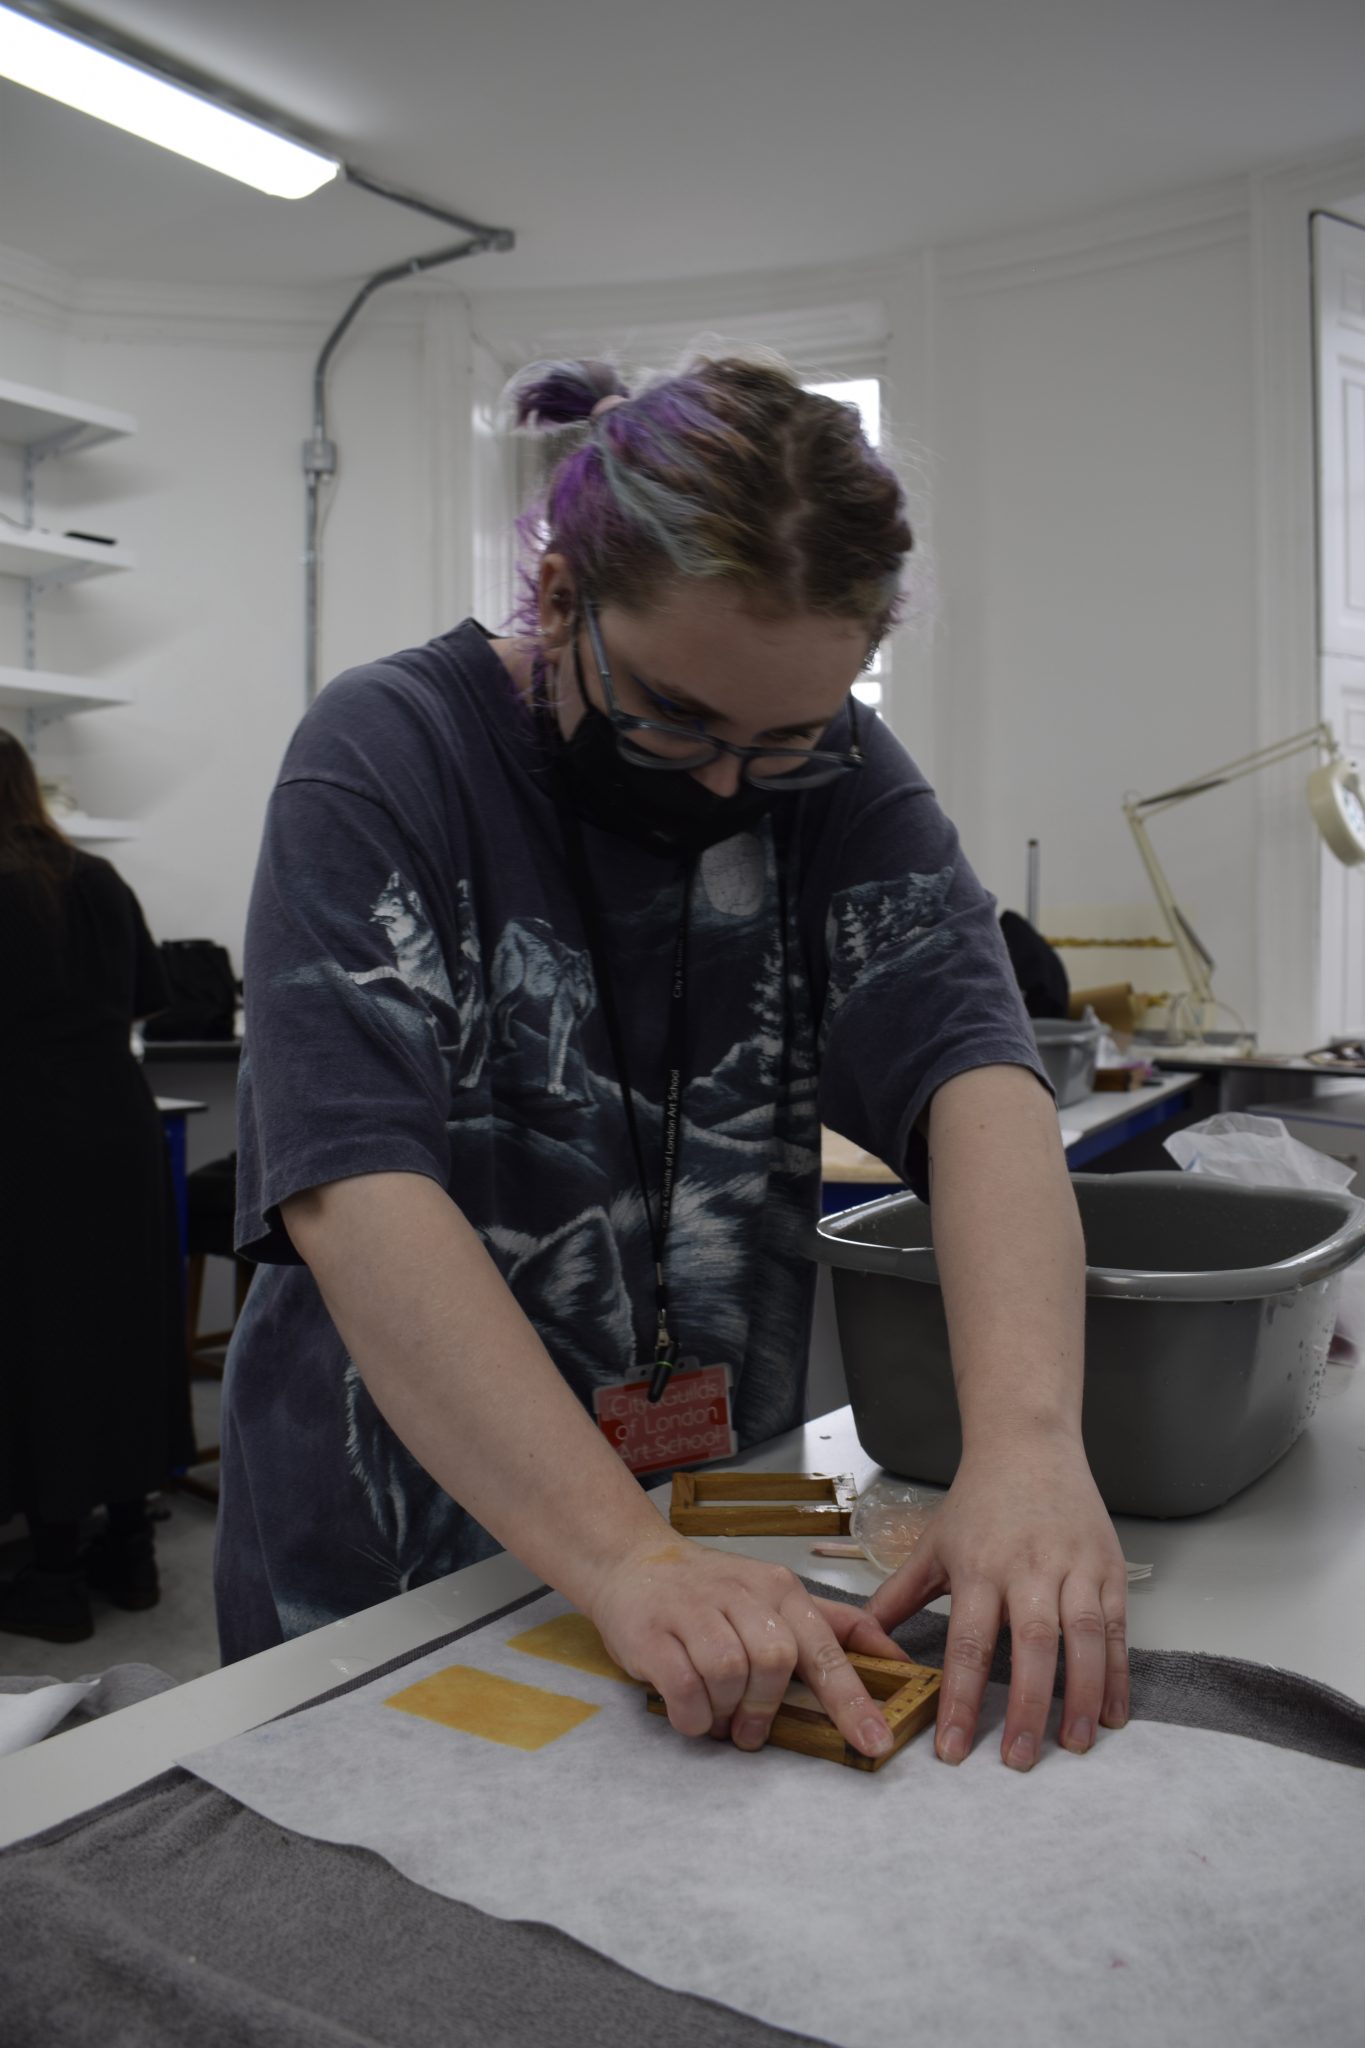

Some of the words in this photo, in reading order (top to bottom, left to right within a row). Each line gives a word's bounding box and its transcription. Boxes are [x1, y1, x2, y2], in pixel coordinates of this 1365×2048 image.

[673, 979, 684, 998] City
[667, 1069, 680, 1101] School
[667, 1104, 678, 1119] Art
[664, 1120, 677, 1154] London
[664, 1156, 673, 1167] of
[662, 1169, 672, 1198] Guilds
[663, 1379, 718, 1406] Guilds
[615, 1418, 639, 1440] of
[645, 1406, 718, 1434] London
[618, 1442, 651, 1461] Art
[655, 1426, 720, 1457] School
